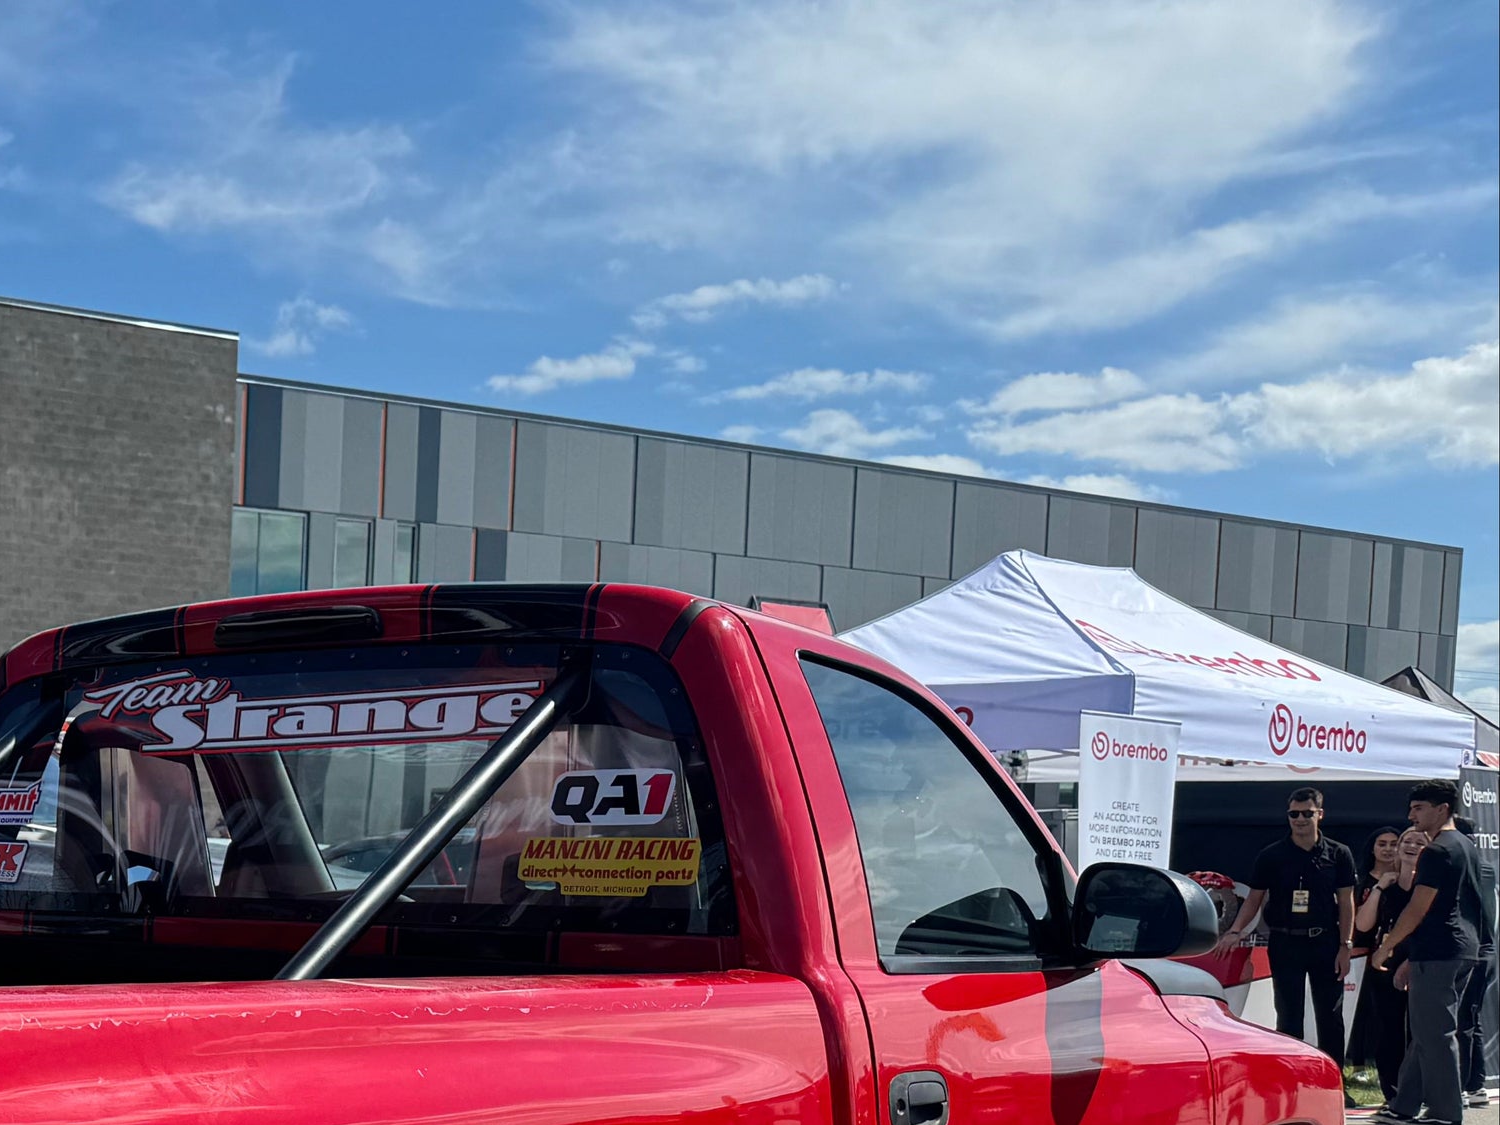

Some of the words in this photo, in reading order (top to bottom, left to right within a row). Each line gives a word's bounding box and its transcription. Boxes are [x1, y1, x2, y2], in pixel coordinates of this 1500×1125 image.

[86, 671, 229, 717] Team
[142, 691, 533, 751] Strange
[1297, 716, 1367, 754] brembo
[1112, 739, 1168, 762] brembo
[551, 774, 673, 823] QA1
[1472, 786, 1497, 804] brembo
[1112, 800, 1140, 811] CREATE
[1093, 812, 1104, 821] AN
[1105, 813, 1140, 823] ACCOUNT
[1142, 816, 1158, 825] FOR
[1089, 823, 1109, 833] MORE
[1110, 825, 1162, 838] INFORMATION
[524, 840, 614, 860] MANCINI
[615, 840, 697, 860] RACING
[1090, 835, 1102, 845] ON
[1102, 836, 1134, 847] BREMBO
[1135, 839, 1160, 849] PARTS
[1095, 848, 1111, 858] AND
[1112, 849, 1127, 859] GET
[1134, 852, 1152, 861] FREE
[521, 865, 559, 879] direct
[578, 866, 651, 881] connection
[655, 867, 694, 883] parts
[602, 886, 645, 894] MICHIGAN
